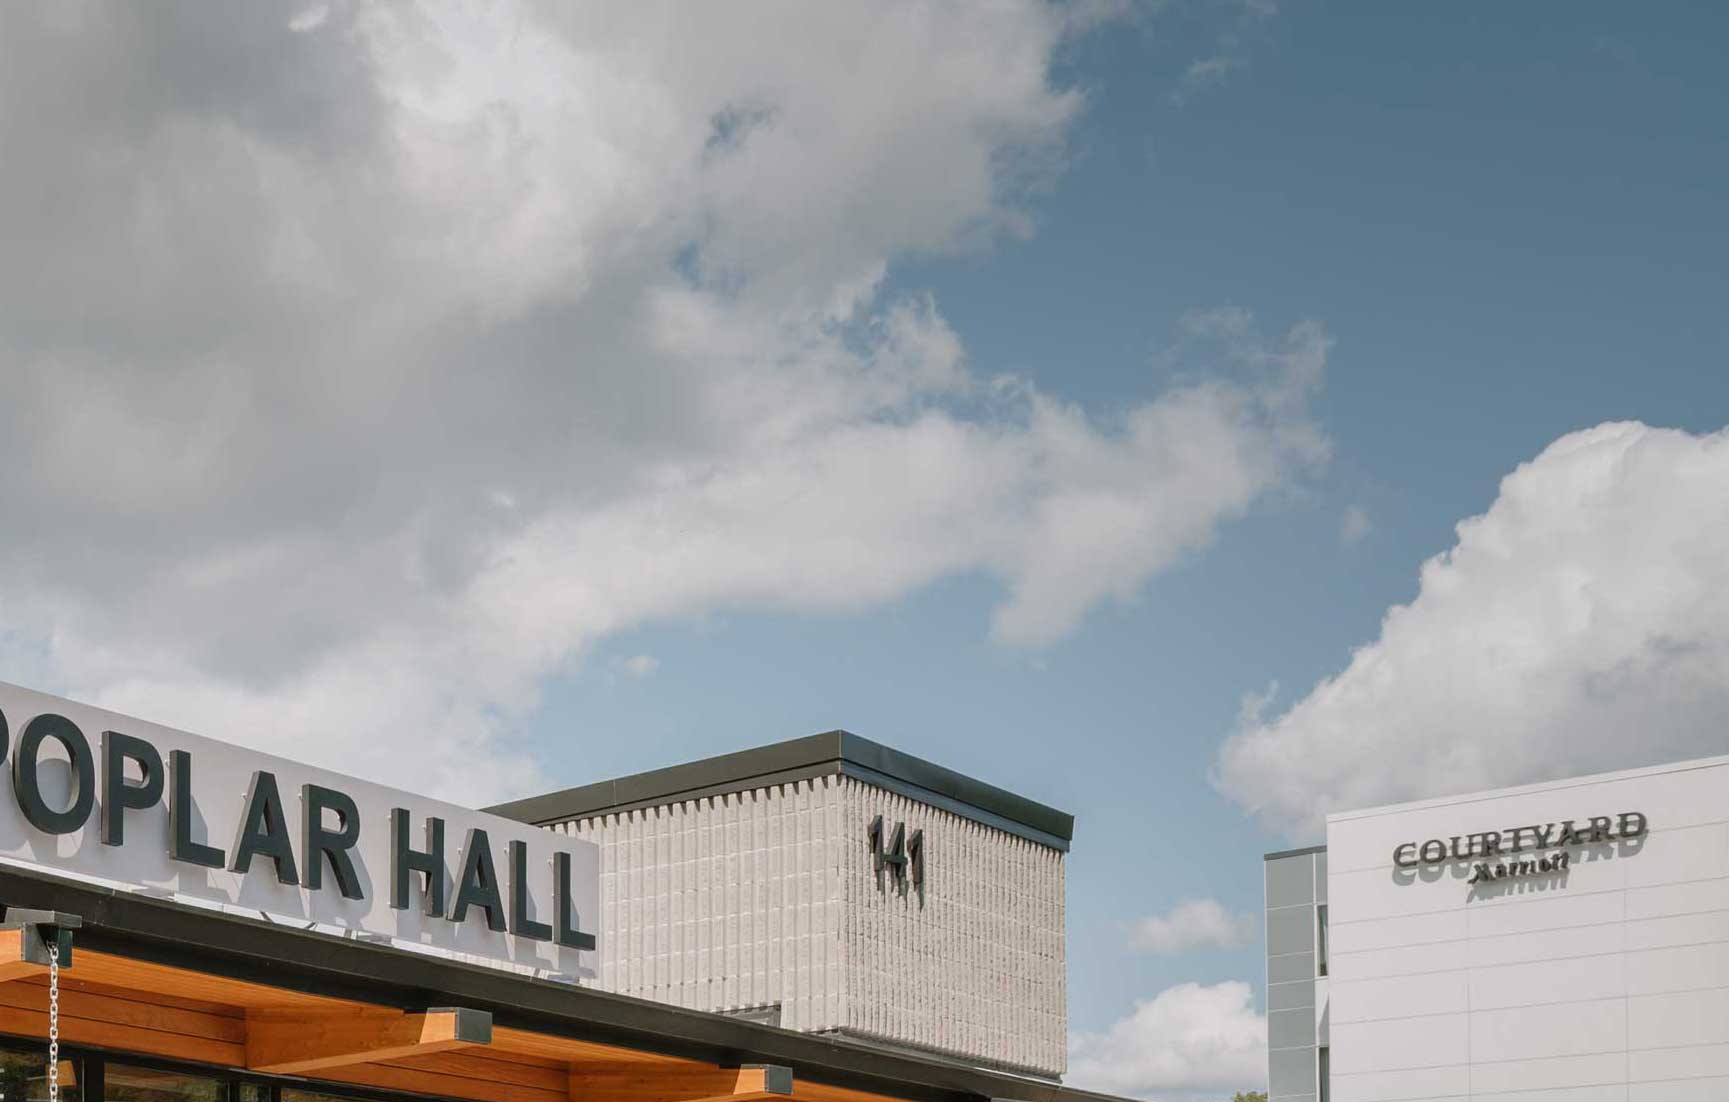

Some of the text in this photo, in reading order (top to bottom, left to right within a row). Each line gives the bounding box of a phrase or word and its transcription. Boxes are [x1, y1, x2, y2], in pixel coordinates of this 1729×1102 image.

[867, 814, 924, 884] 141
[1393, 811, 1648, 868] COURTYARD
[1468, 852, 1570, 884] Marriott
[390, 807, 596, 951] HALL
